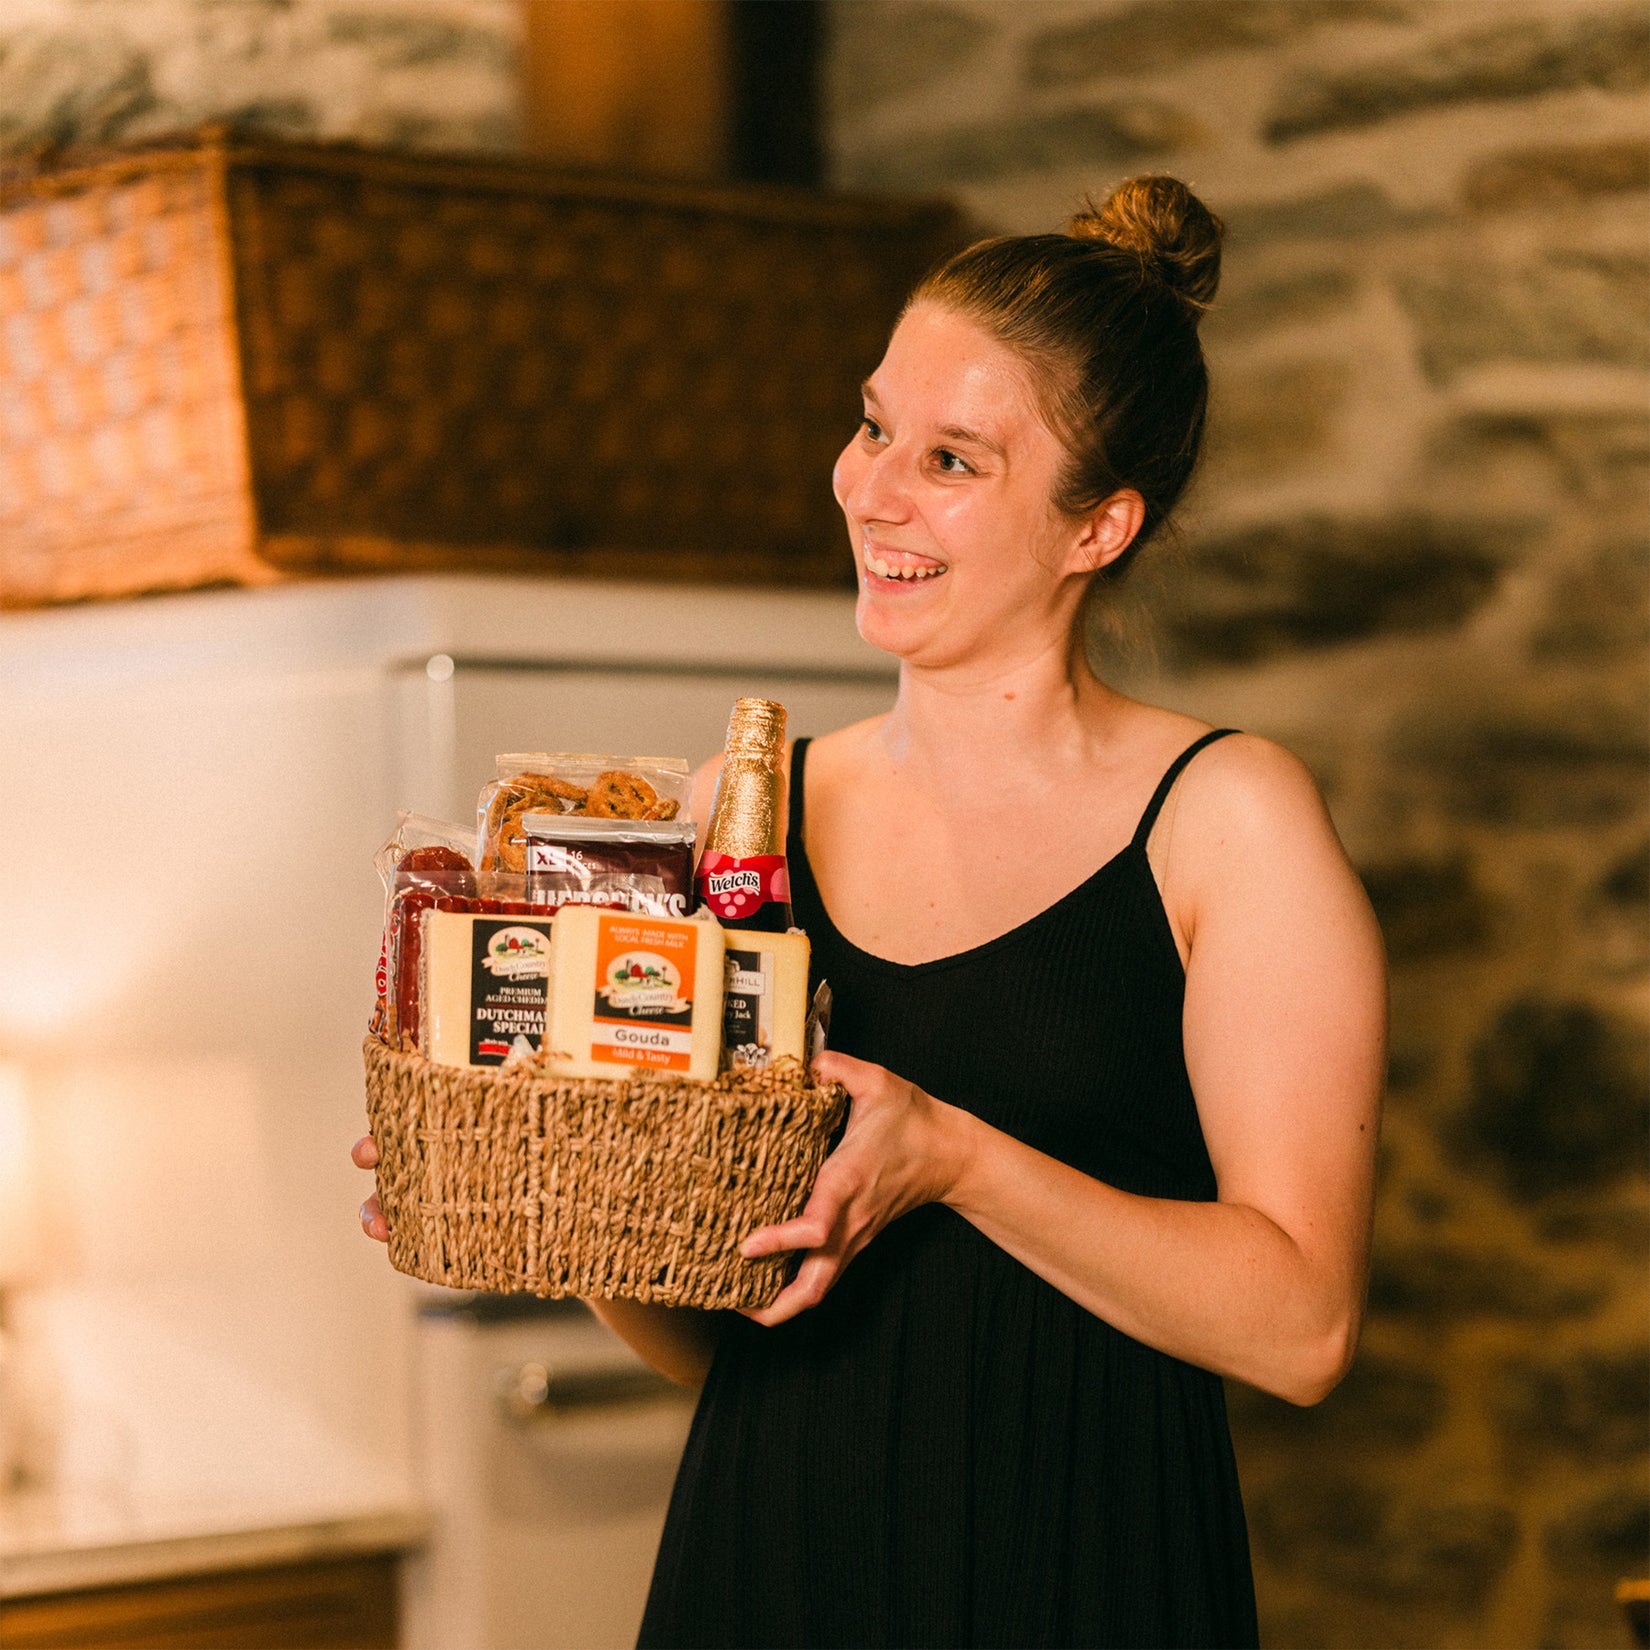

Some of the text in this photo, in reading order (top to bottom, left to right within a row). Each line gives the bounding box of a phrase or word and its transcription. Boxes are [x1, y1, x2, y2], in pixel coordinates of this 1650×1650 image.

[571, 850, 583, 861] 16
[710, 872, 760, 893] Welch's
[609, 925, 688, 942] ALWAYS MADE WITH
[614, 934, 685, 949] LOCAL FRESH MILK
[485, 994, 511, 1004] AGED
[499, 986, 542, 997] PREMIUM
[615, 1028, 670, 1047] Gouda
[613, 1047, 671, 1066] Mild & Tasty
